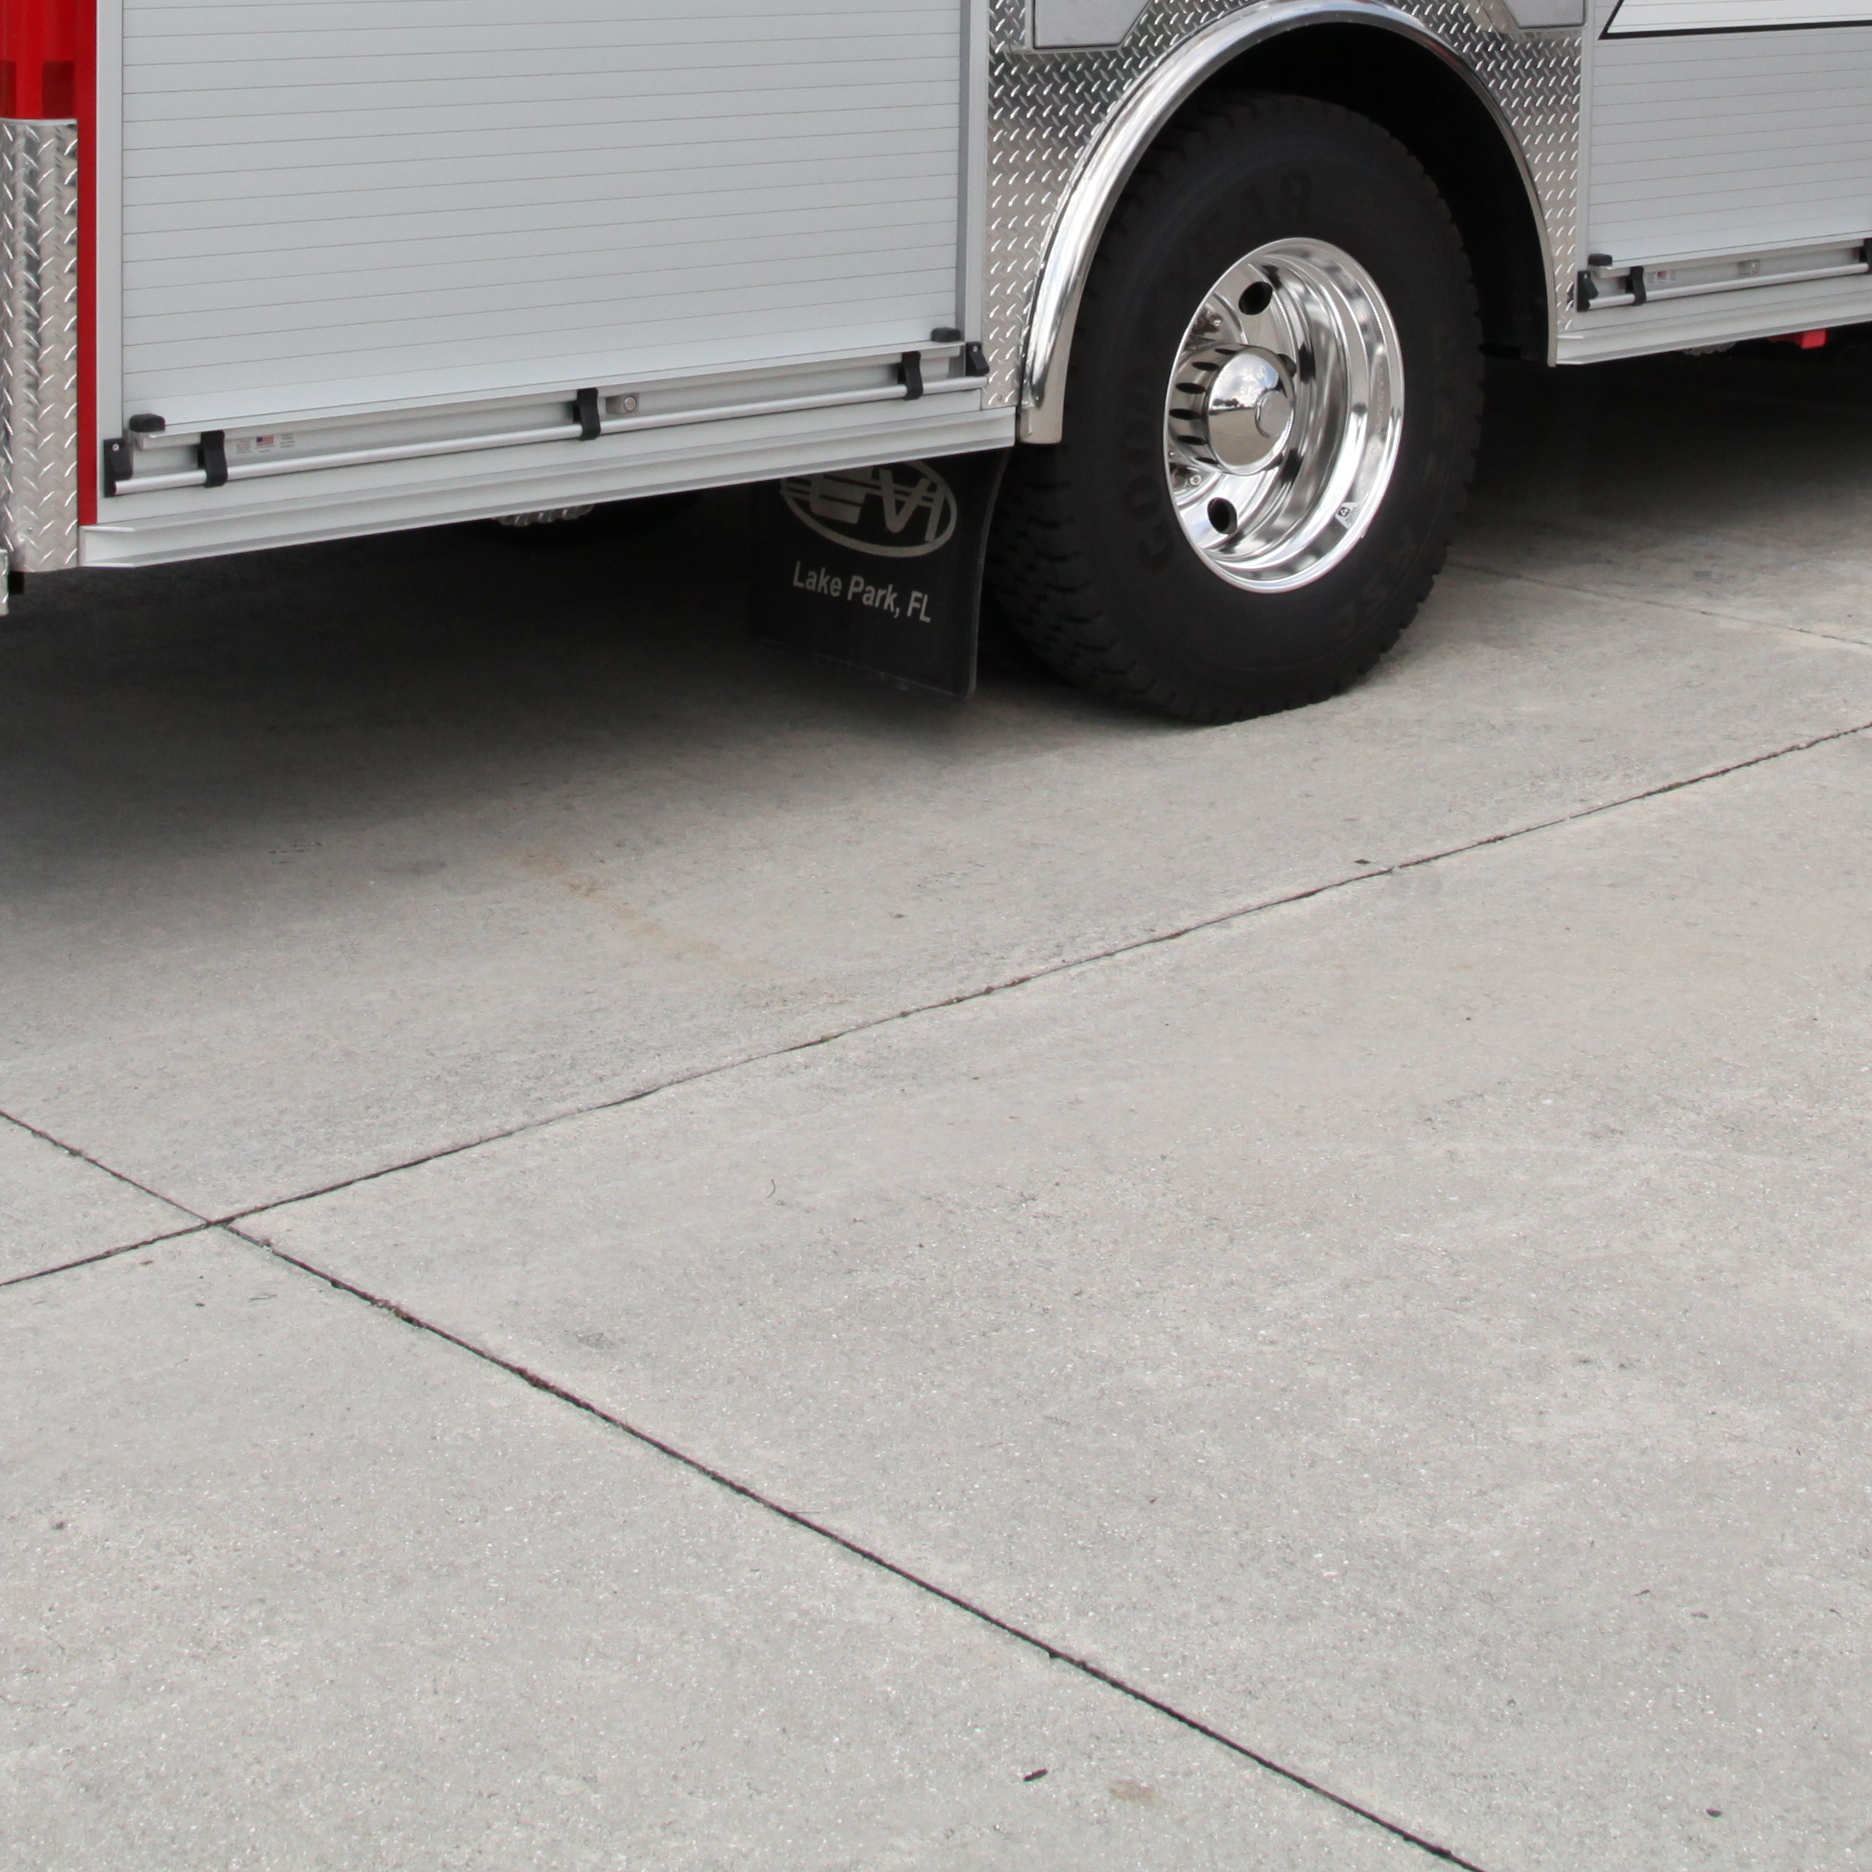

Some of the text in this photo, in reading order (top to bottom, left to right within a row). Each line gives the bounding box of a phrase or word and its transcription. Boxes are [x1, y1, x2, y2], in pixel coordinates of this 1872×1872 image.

[792, 560, 932, 623] Lake Park, FL
